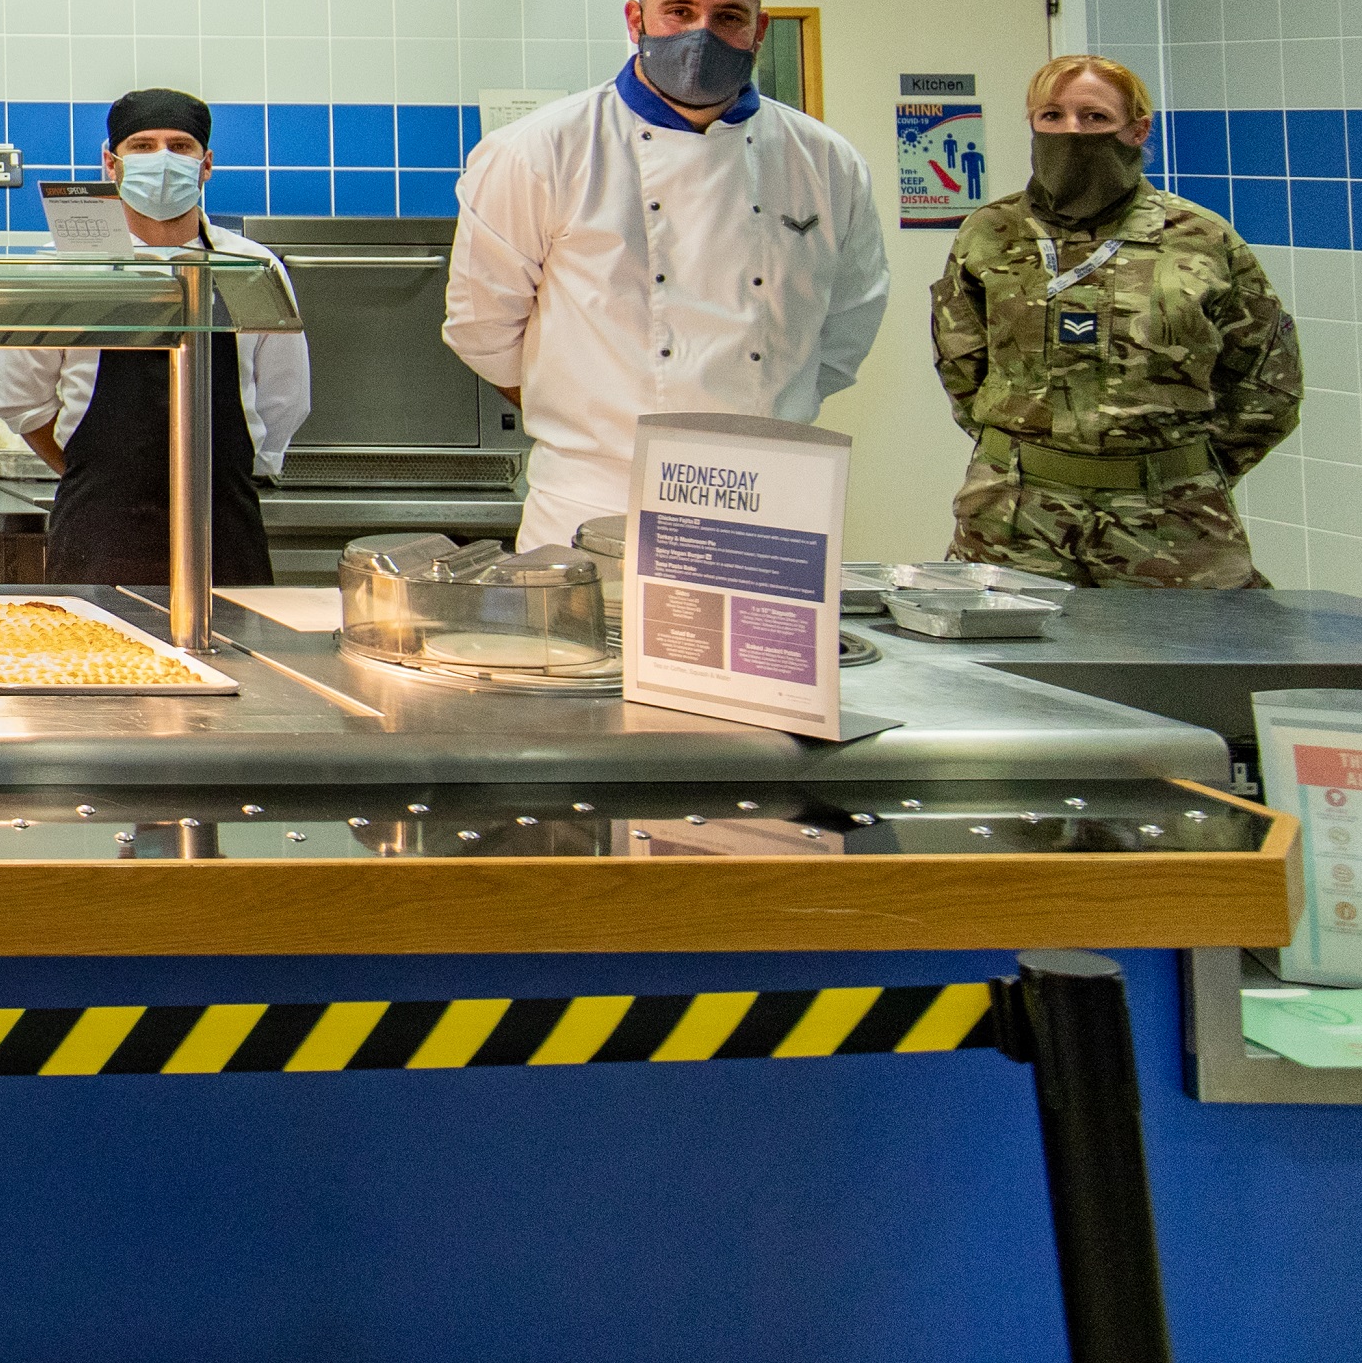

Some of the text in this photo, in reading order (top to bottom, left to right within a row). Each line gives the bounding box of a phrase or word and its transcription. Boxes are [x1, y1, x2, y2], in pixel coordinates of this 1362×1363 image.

[912, 78, 964, 91] Kitchen
[896, 104, 943, 117] THINK!
[897, 117, 929, 125] COVID-19
[900, 176, 924, 185] KEEP
[45, 187, 89, 196] SERVICE SPECIAL
[900, 186, 928, 195] YOUR
[900, 195, 950, 204] DISTANCE
[661, 461, 759, 492] WEDNESDAY
[659, 481, 761, 513] LUNCH MENU
[657, 514, 694, 526] Chicken Fajita
[656, 533, 674, 542] Turkey
[679, 535, 708, 546] Mushroom
[671, 549, 688, 558] Vegan
[655, 560, 697, 572] Tuna Pasta Bake
